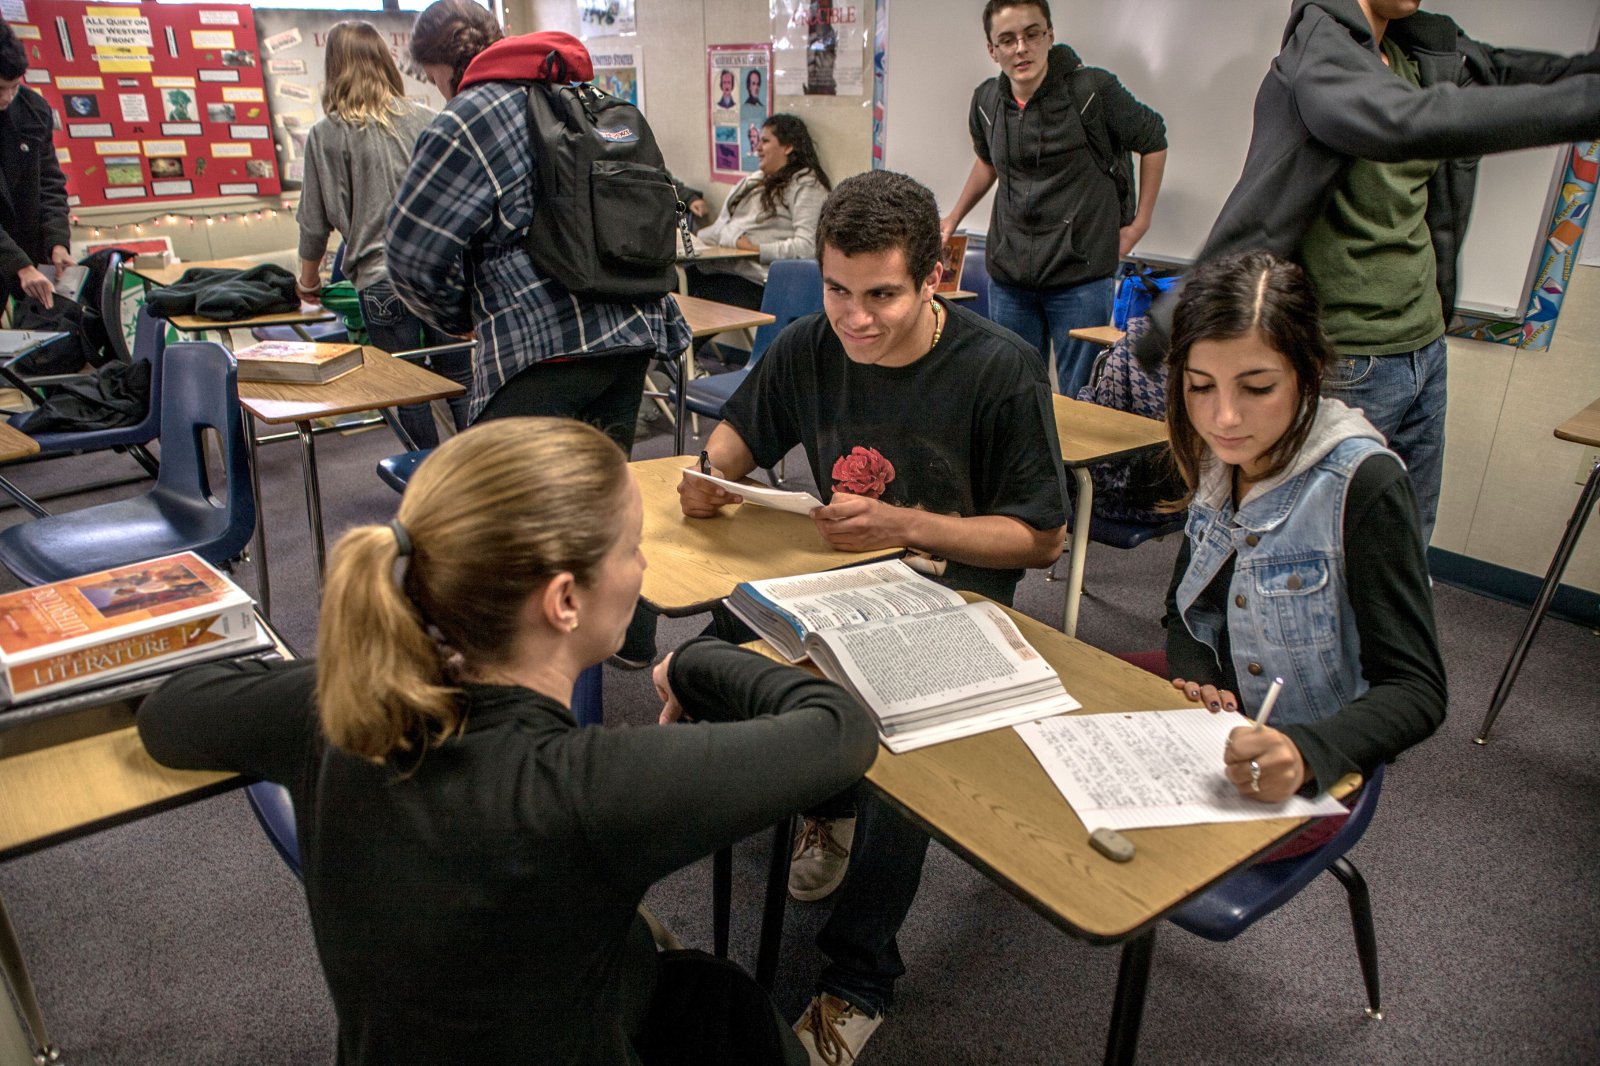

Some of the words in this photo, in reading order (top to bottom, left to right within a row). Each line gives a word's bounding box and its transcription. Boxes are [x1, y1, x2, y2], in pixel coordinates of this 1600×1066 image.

[85, 17, 104, 26] ALL
[106, 18, 132, 26] QUIET
[88, 27, 104, 35] THE
[106, 27, 149, 35] WESTERN
[105, 36, 135, 44] FRONT
[33, 636, 171, 686] LITERATURE
